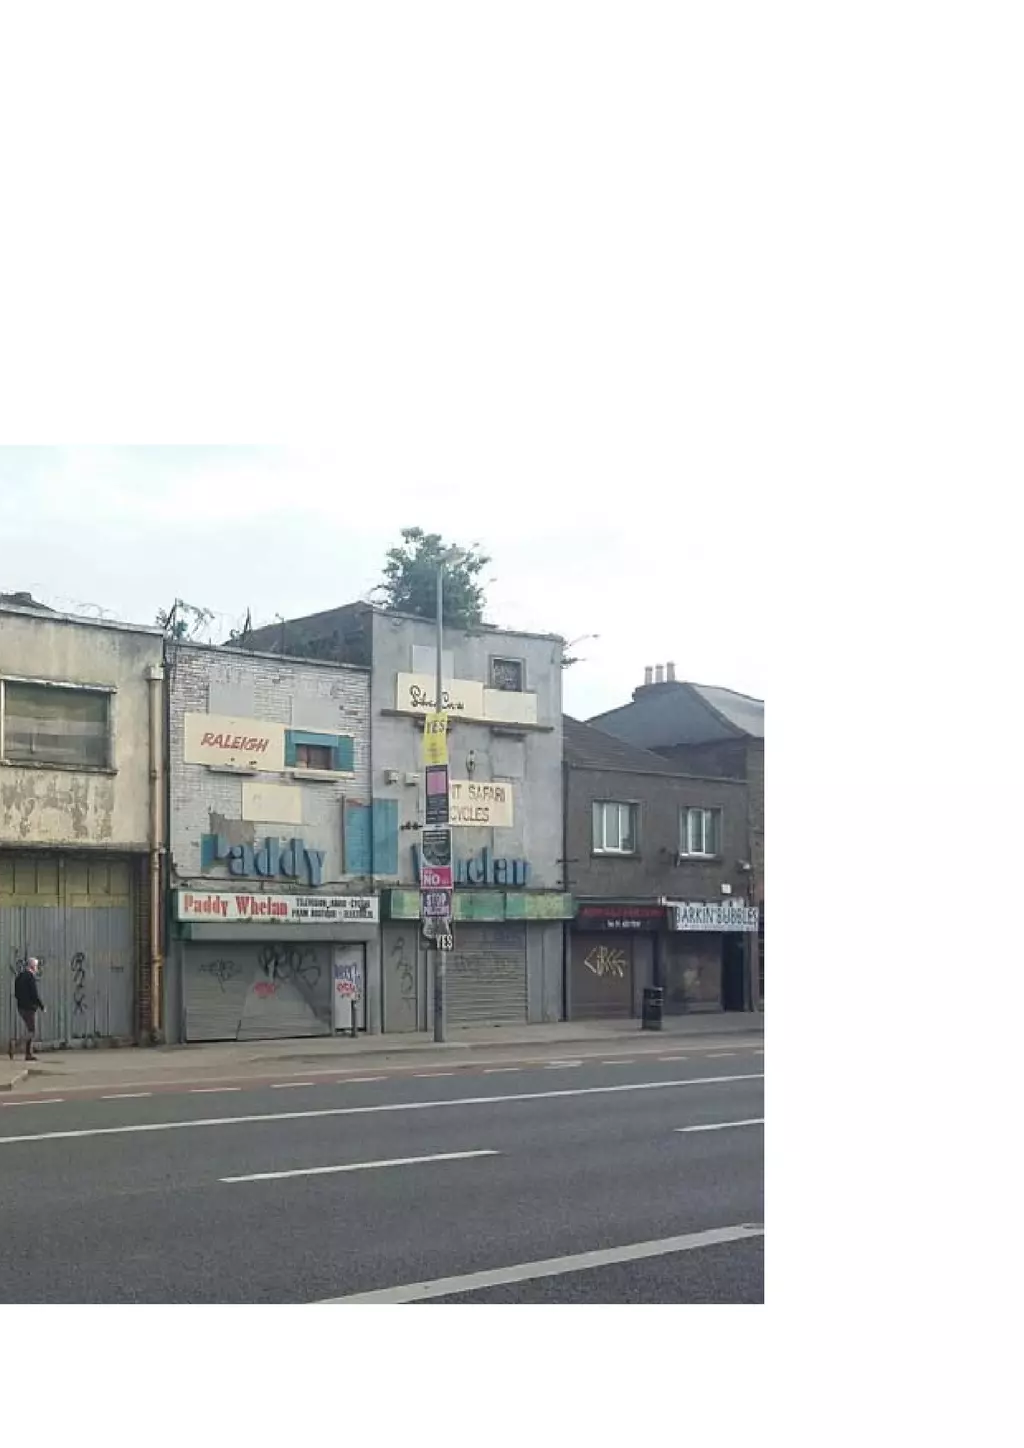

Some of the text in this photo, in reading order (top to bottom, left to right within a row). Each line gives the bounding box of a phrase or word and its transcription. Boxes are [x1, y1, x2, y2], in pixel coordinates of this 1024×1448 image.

[200, 732, 270, 752] RALEIGH
[184, 893, 288, 917] Paddy Whelan
[436, 934, 453, 949] YES
